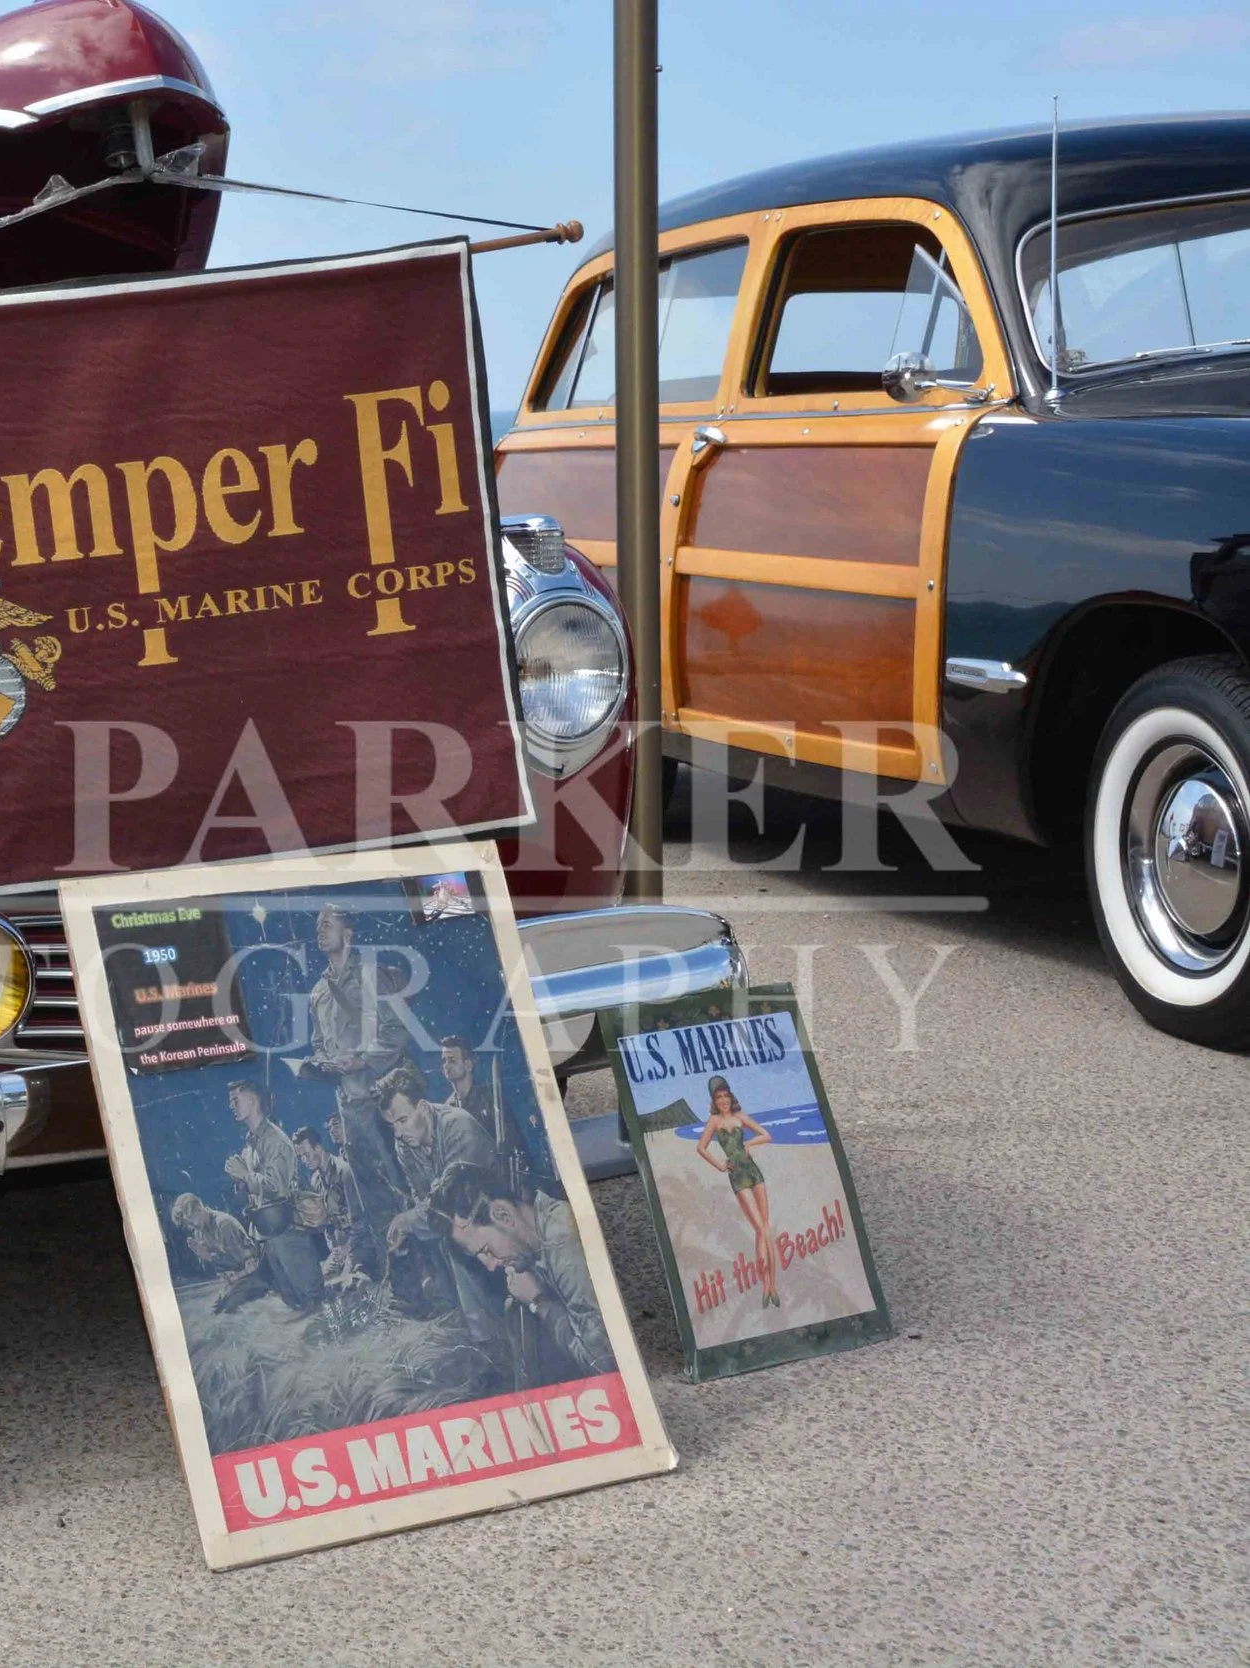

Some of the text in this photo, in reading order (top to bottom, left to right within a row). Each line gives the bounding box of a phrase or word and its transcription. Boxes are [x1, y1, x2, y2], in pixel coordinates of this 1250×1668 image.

[343, 379, 469, 637] Fi
[64, 557, 477, 634] U.S. MARINE CORPS
[111, 906, 202, 929] Christmas Eve
[142, 947, 177, 965] 1950
[134, 980, 219, 1004] U.S. Marines
[133, 1014, 240, 1038] pause somewhere on
[139, 1041, 247, 1065] the Korean Peninsula
[618, 1015, 787, 1084] U.S. MARINES
[693, 1199, 846, 1314] Hit the Beach!
[347, 1388, 622, 1496] MARINES
